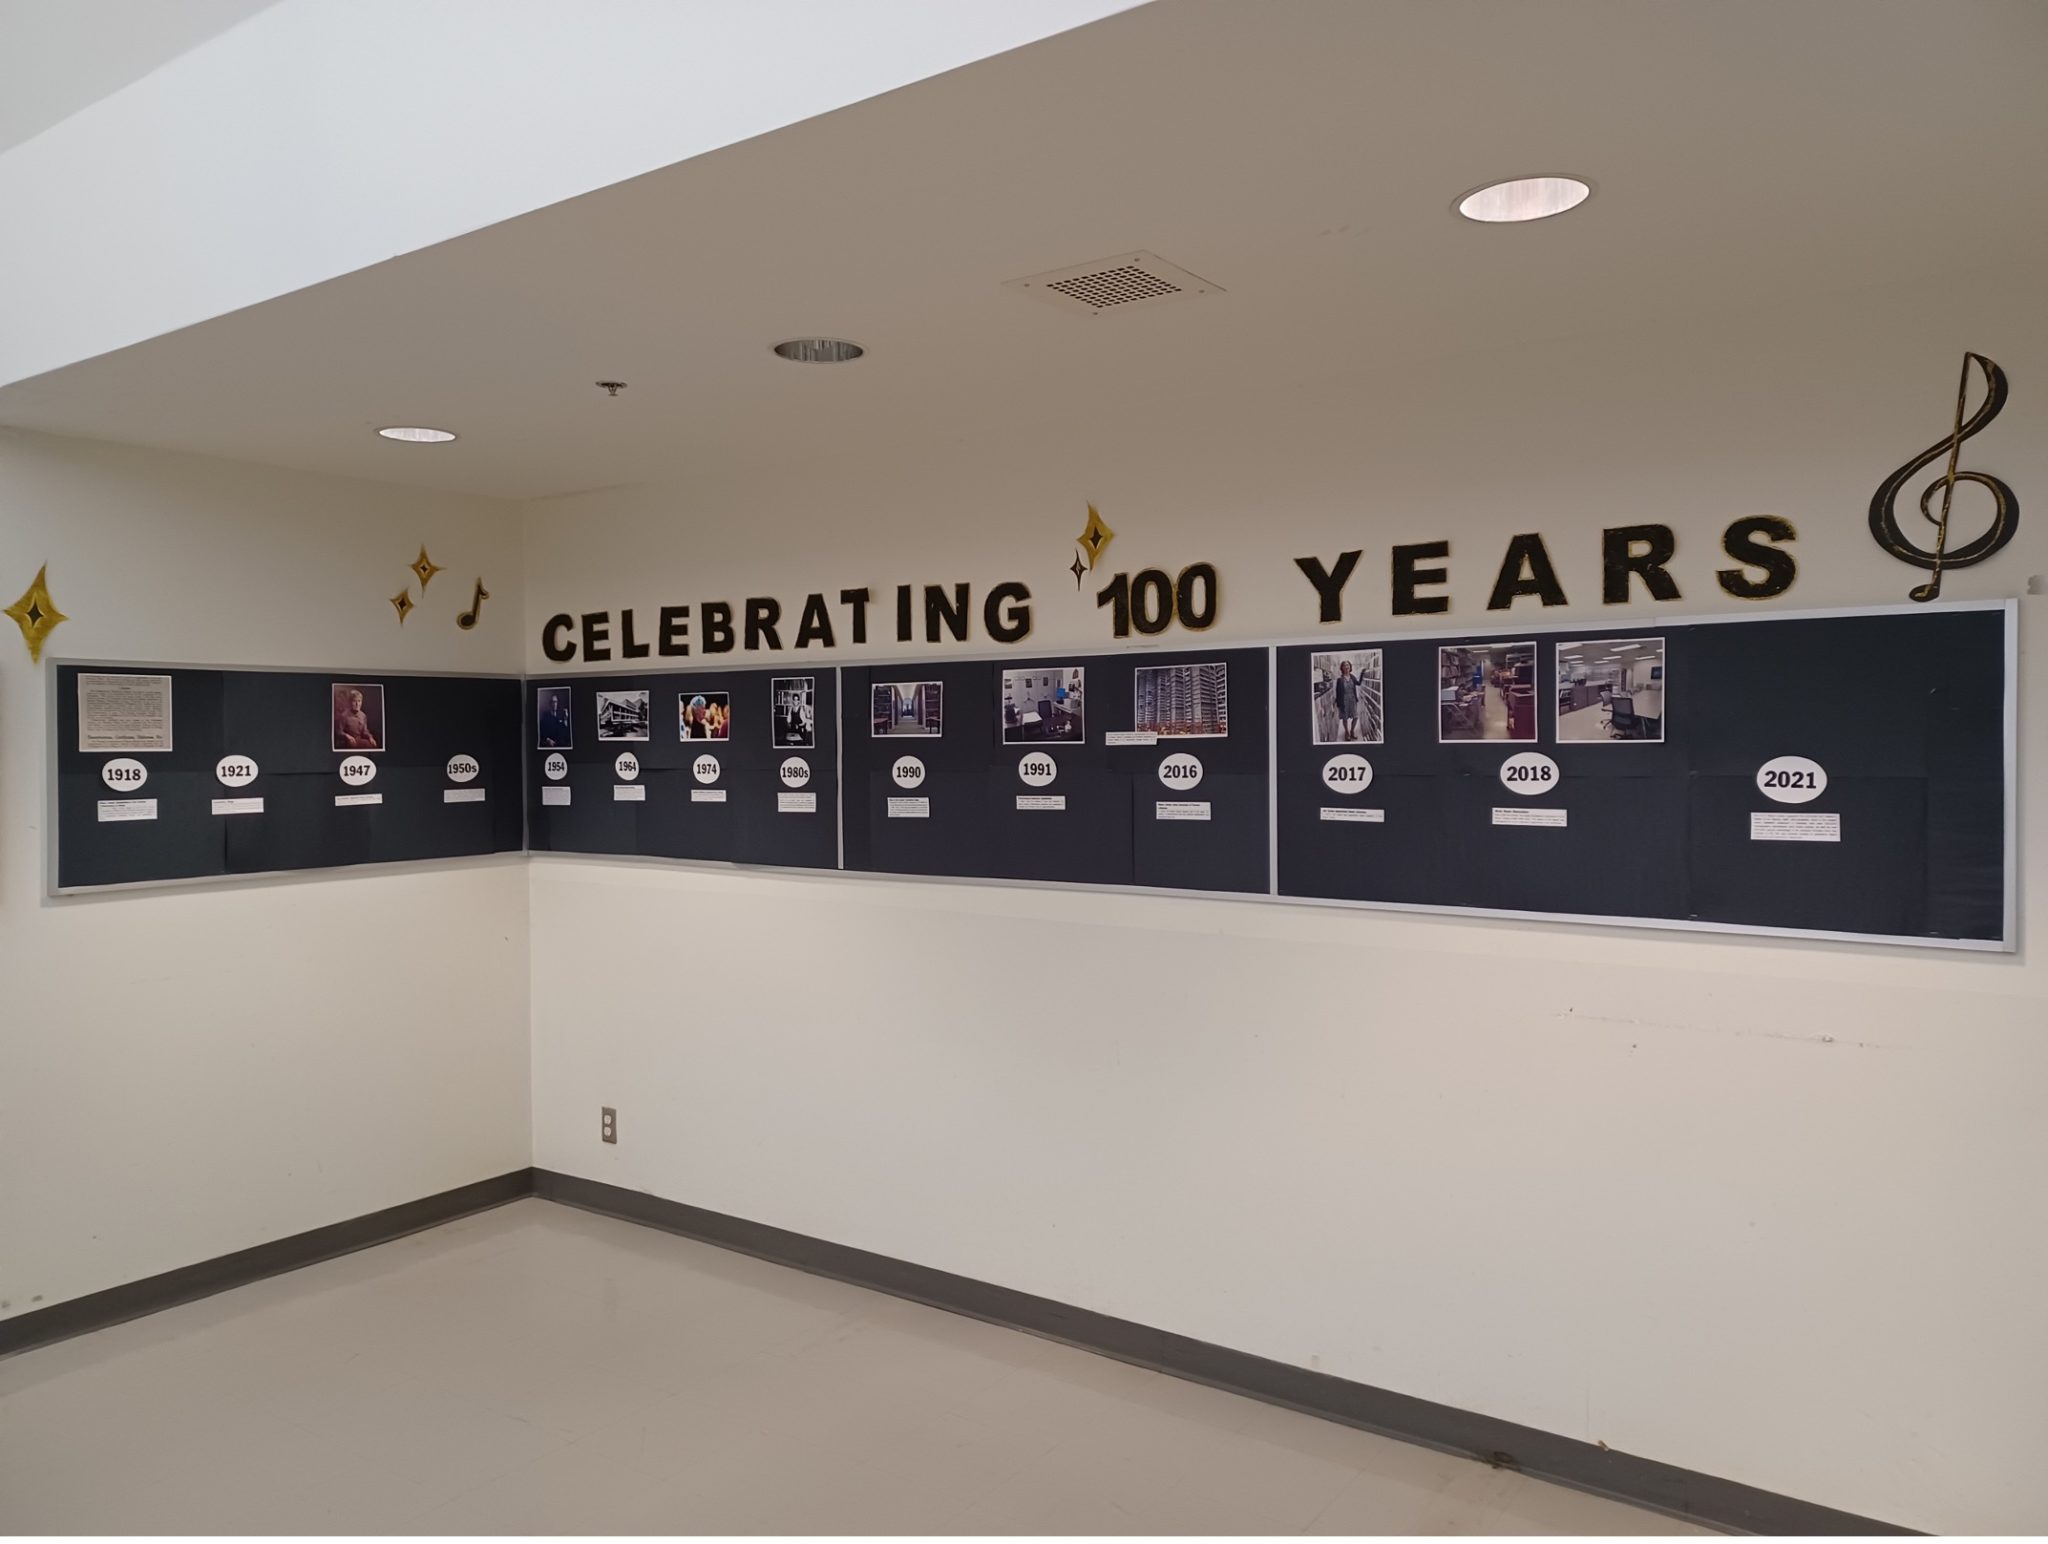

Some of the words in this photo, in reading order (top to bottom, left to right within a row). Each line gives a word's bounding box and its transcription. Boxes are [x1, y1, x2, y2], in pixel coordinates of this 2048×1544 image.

[541, 580, 1032, 664] CELEBRATING
[1096, 562, 1219, 639] 100
[1293, 514, 1799, 624] YEARS
[221, 765, 251, 778] 1921
[343, 765, 371, 777] 1947
[447, 762, 478, 775] 1950s
[547, 761, 566, 772] 1954
[618, 760, 637, 772] 1964
[696, 763, 718, 775] 1974
[781, 766, 809, 779] 1980s
[895, 766, 922, 779] 1990
[1023, 762, 1052, 776] 1991
[1163, 764, 1198, 779] 2016
[107, 767, 142, 782] 1918
[1328, 766, 1367, 782] 2017
[1506, 765, 1552, 782] 2018
[1763, 770, 1818, 789] 2021
